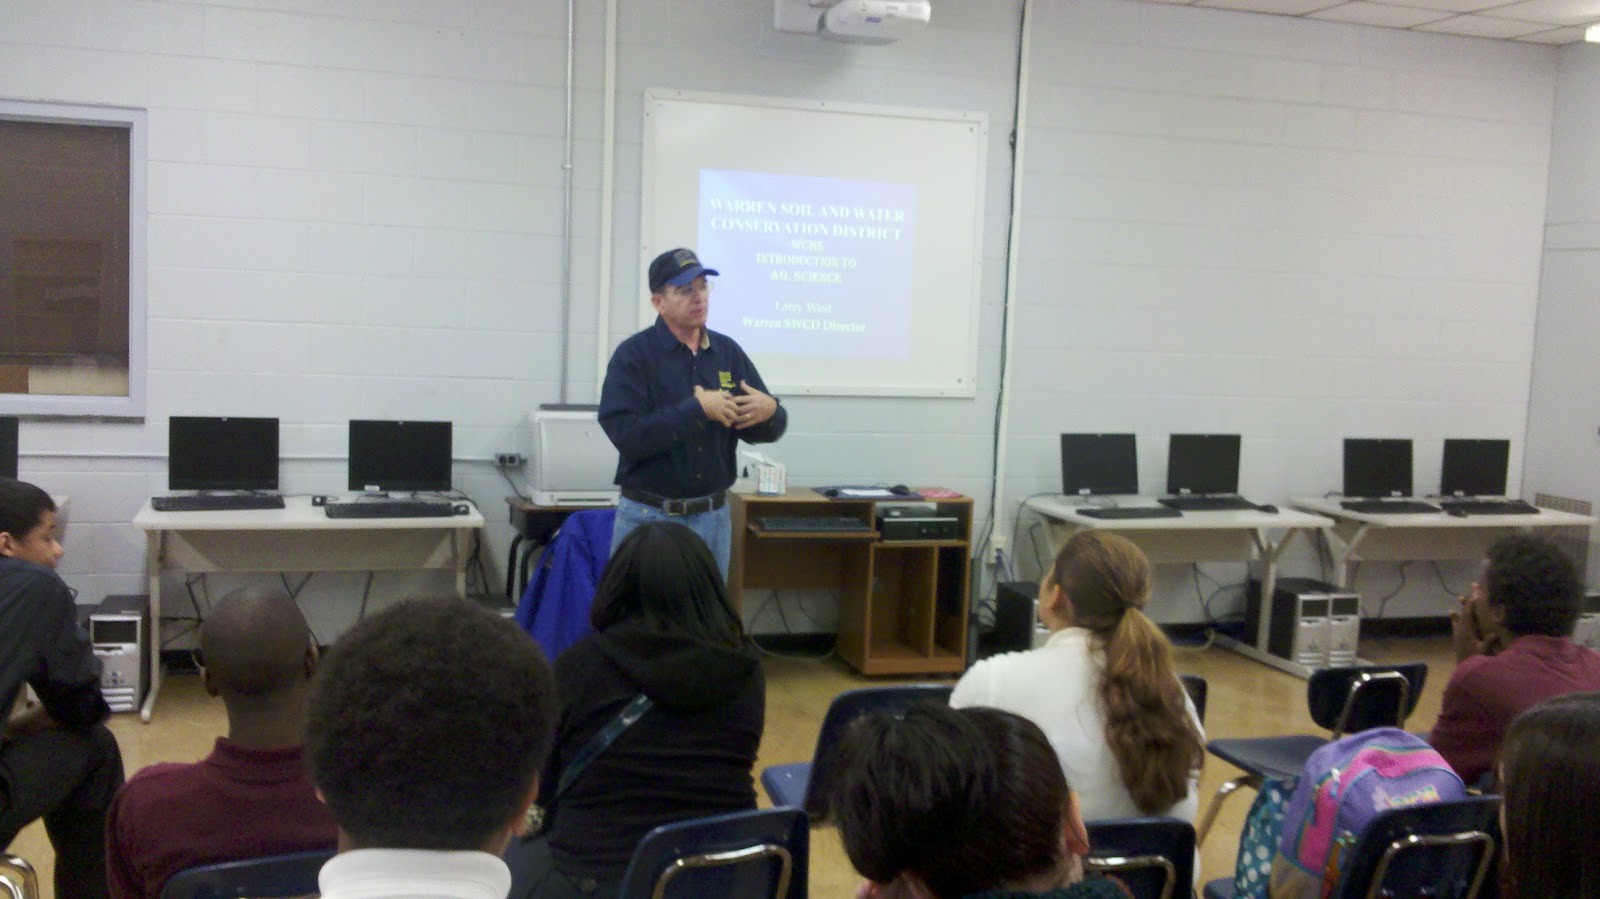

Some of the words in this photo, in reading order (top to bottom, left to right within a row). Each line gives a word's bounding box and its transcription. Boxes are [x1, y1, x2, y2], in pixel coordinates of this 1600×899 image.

[709, 198, 778, 214] WARREN
[779, 202, 816, 217] SOIL
[820, 205, 850, 219] AND
[853, 206, 905, 224] WATER
[710, 216, 829, 236] CONSERVATION
[832, 225, 903, 241] DISTRICT
[756, 253, 839, 268] INTRODUCTION
[841, 257, 857, 269] TO
[793, 271, 842, 284] SCIENCE
[775, 300, 804, 313] Larry
[742, 316, 781, 329] Warren
[784, 318, 820, 330] SWCD
[823, 319, 865, 333] Director
